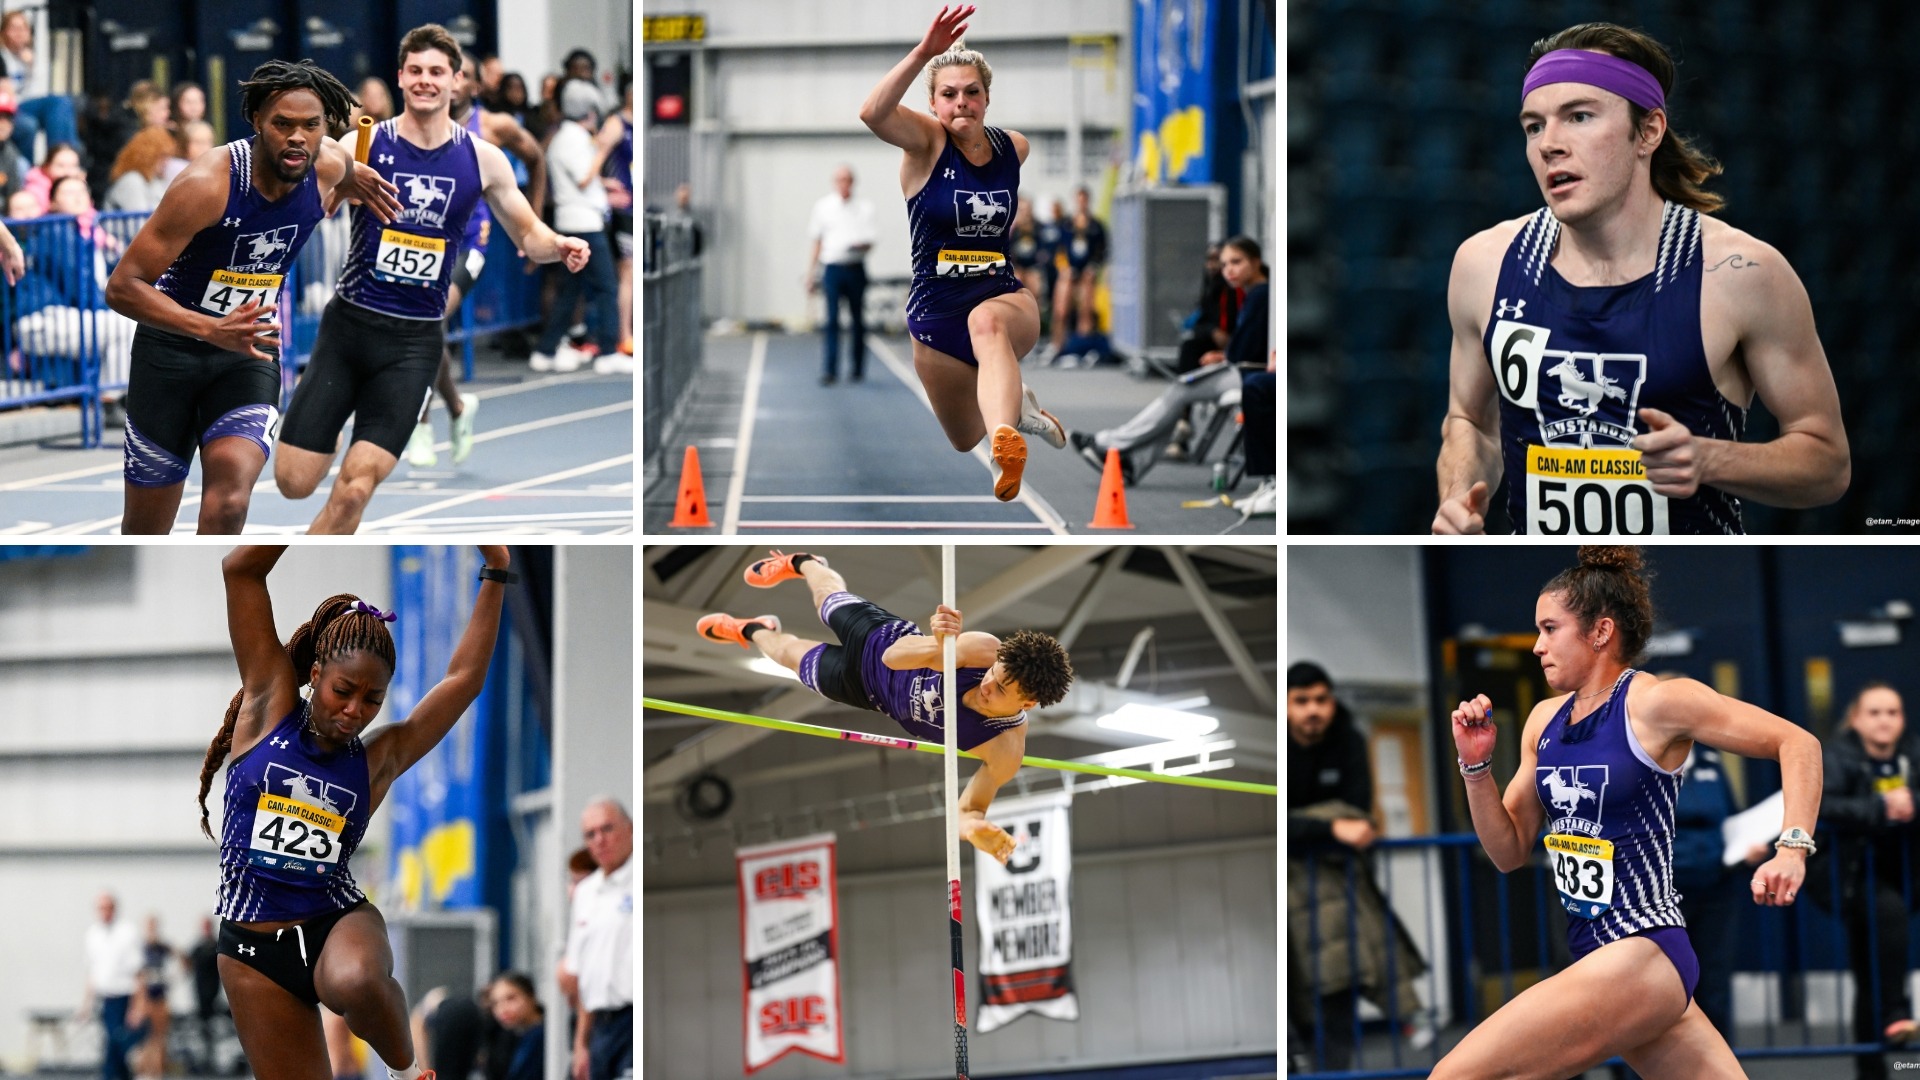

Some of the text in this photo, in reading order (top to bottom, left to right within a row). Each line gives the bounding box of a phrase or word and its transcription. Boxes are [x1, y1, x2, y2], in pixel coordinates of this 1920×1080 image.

[413, 239, 437, 250] CLASSIC
[944, 253, 995, 263] CAN-AM CLASSIC
[382, 247, 437, 278] 452
[219, 274, 273, 287] CAN-AM CLASSIC
[208, 286, 268, 312] 471
[1500, 328, 1536, 401] 6
[1545, 418, 1633, 443] MUSTANGS
[1537, 456, 1643, 476] CAN-AM CLASSIC
[1538, 480, 1654, 535] 500
[267, 800, 300, 815] CAN-AM
[300, 809, 332, 828] CLASSIC
[258, 816, 333, 859] 423
[1571, 842, 1601, 855] CLASSIC
[755, 861, 821, 897] CIS
[1556, 852, 1604, 899] 433
[760, 994, 826, 1033] SIC
